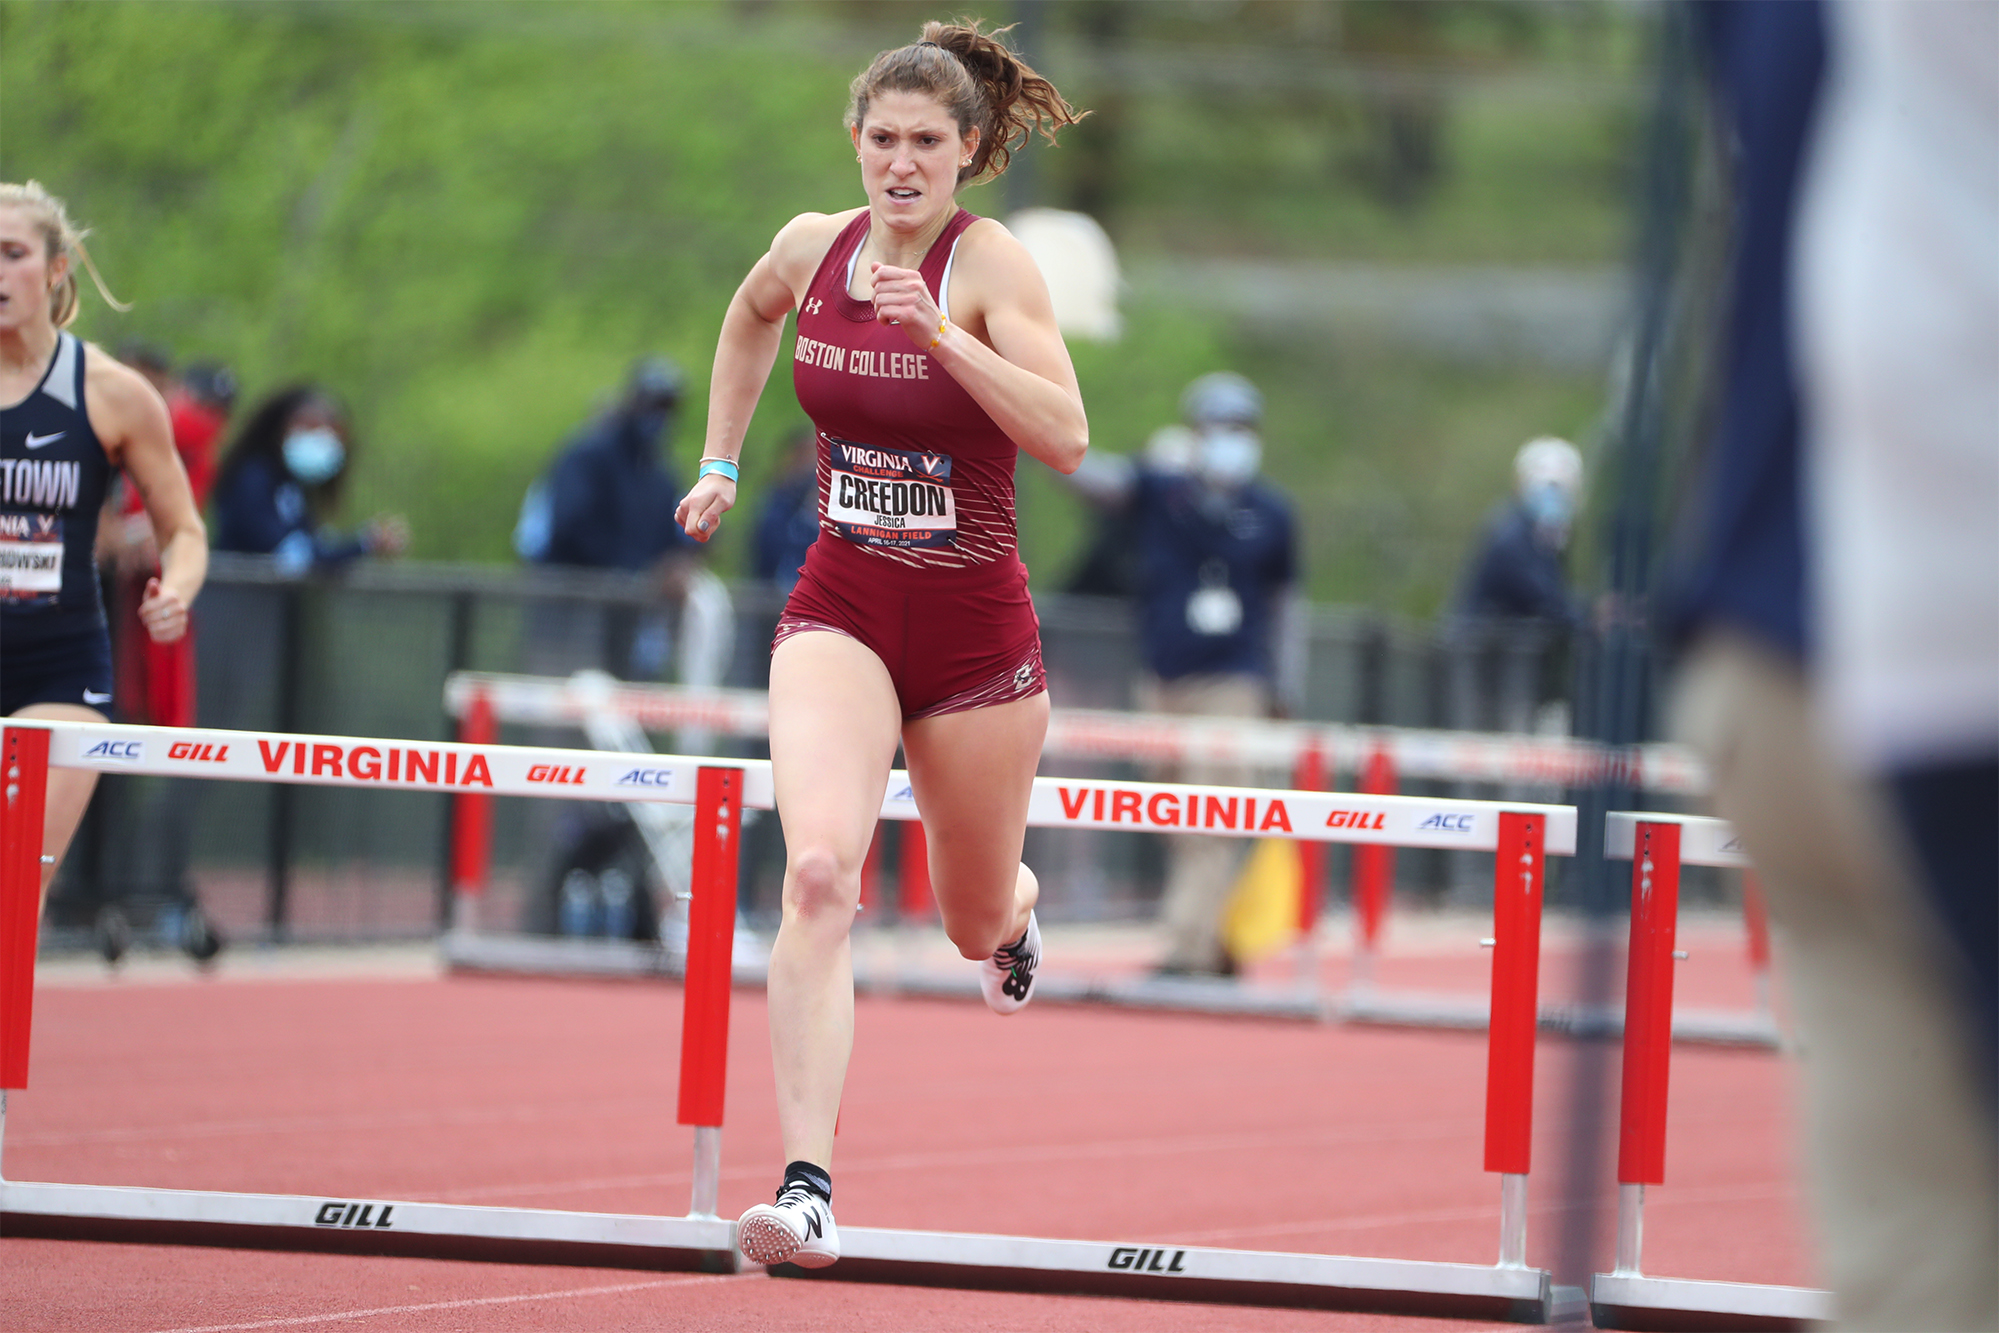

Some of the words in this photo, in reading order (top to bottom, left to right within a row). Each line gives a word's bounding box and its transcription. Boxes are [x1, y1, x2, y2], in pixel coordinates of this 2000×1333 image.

[794, 334, 847, 372] BOSTON
[848, 349, 930, 380] COLLEGE
[841, 444, 913, 473] VIRGINIA
[852, 464, 904, 478] CHALLENGE
[0, 458, 80, 509] TOWN
[838, 473, 947, 517] CREEDON
[850, 525, 899, 540] LANNIGAN
[902, 531, 932, 540] FIELD
[874, 514, 906, 529] JESSICA
[867, 536, 883, 546] APRIL
[83, 740, 141, 758] ACC
[167, 742, 229, 763] GILL
[257, 739, 494, 787] VIRGINIA
[526, 764, 586, 785] GILL
[617, 767, 673, 787] ACC
[1057, 786, 1293, 833] VIRGINIA
[1325, 810, 1386, 830] GILL
[1416, 812, 1476, 833] ACC
[315, 1202, 394, 1228] GILL
[1107, 1246, 1185, 1274] GILL
